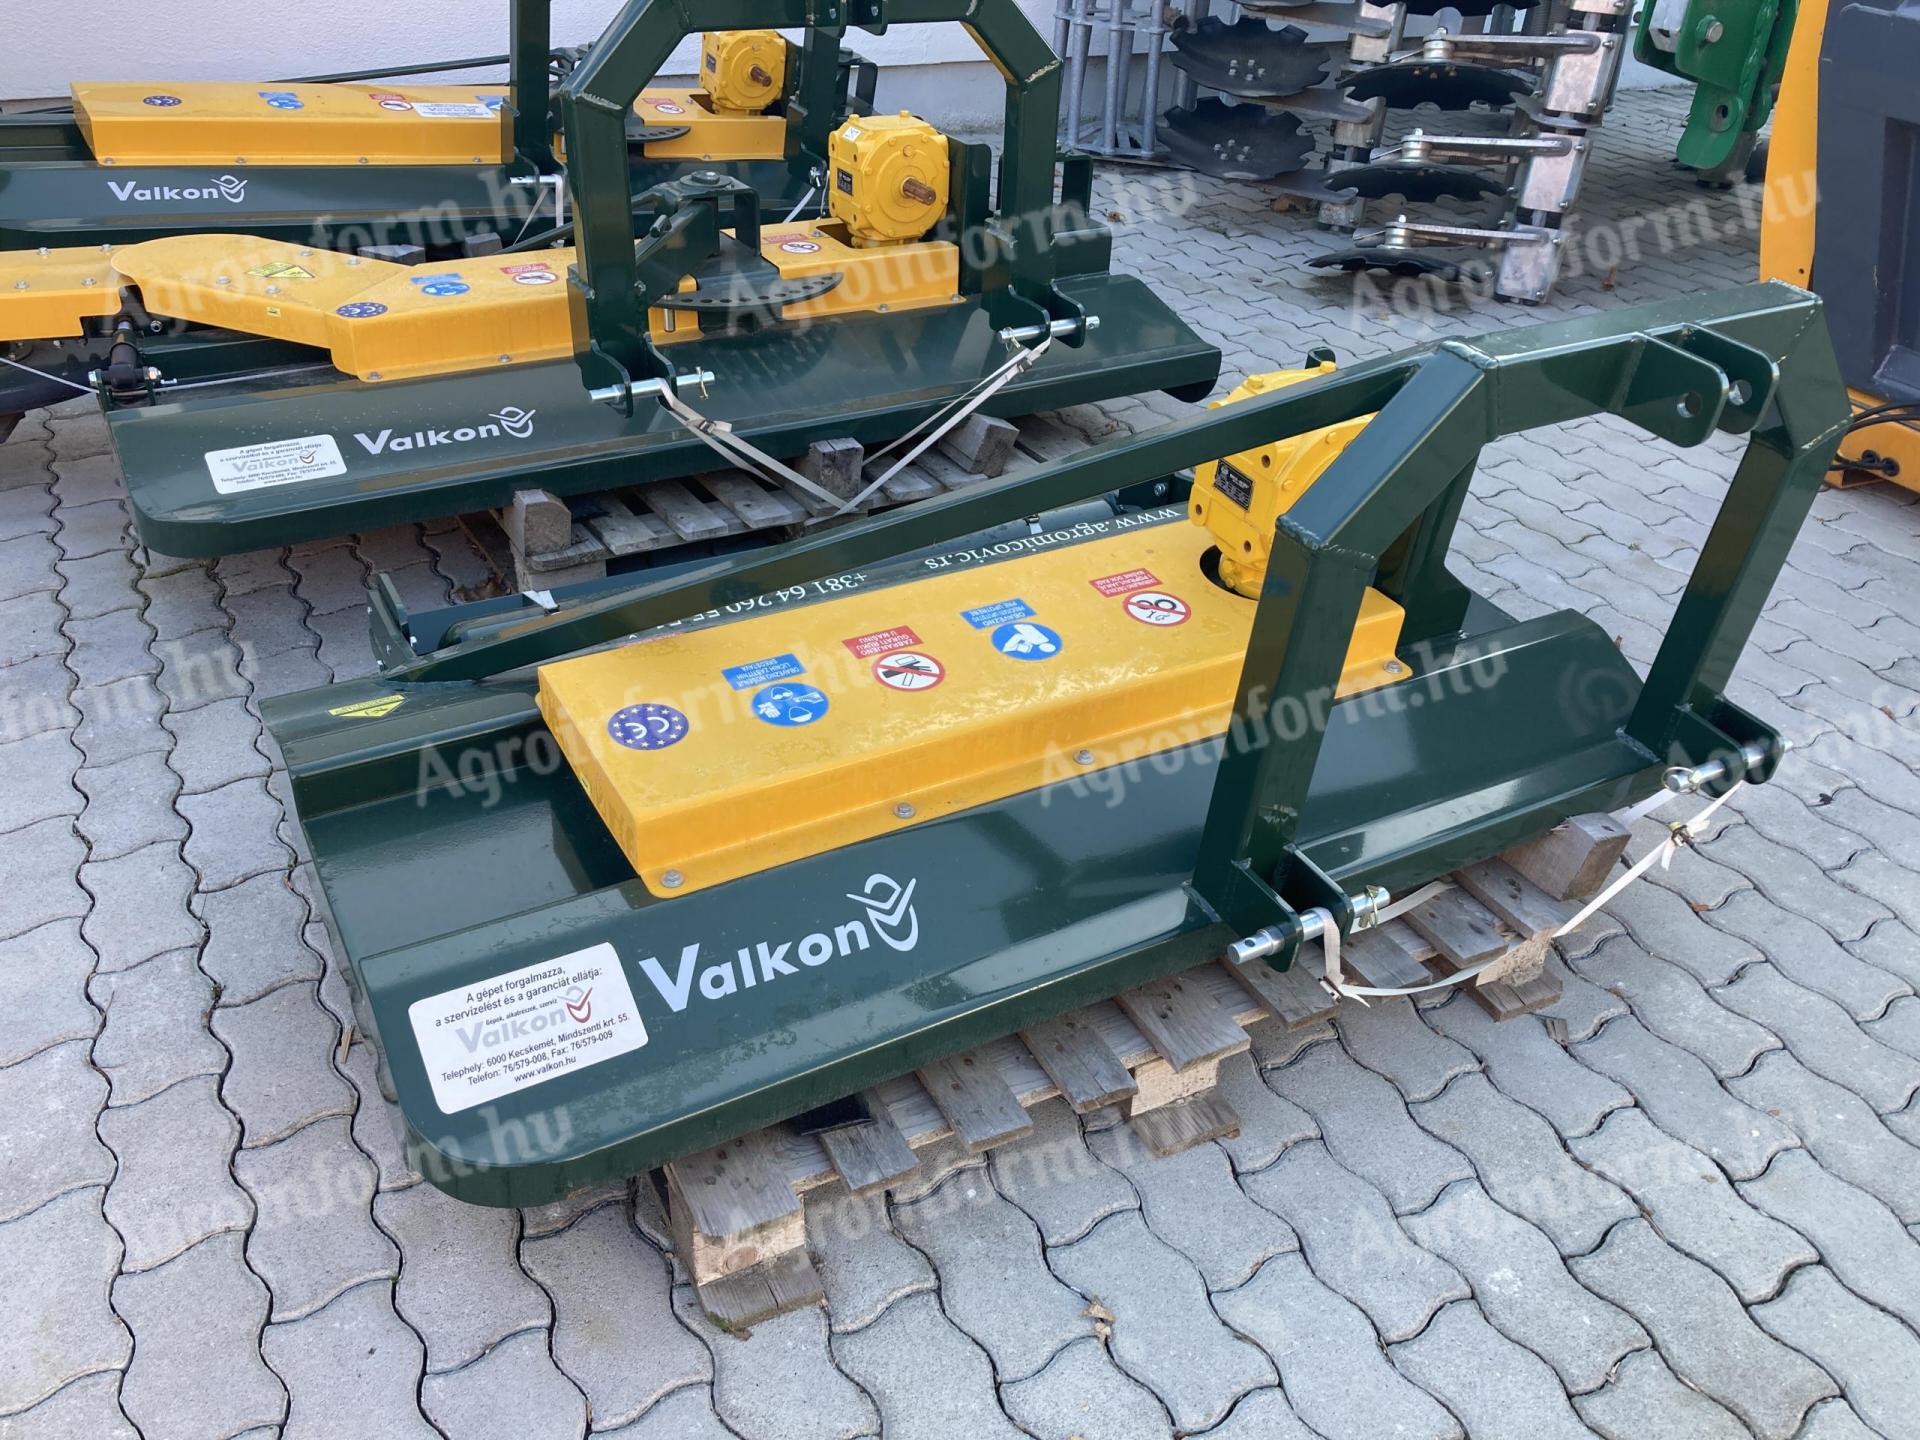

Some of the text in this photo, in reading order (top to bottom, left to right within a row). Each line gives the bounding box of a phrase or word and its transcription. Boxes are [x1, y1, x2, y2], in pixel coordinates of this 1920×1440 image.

[107, 181, 219, 201] Valkon
[353, 424, 500, 455] Valkon
[231, 458, 299, 473] Valkon
[925, 508, 1181, 569] www.agromicovic.rs
[775, 585, 806, 602] 64
[811, 572, 868, 595] +381
[856, 641, 880, 651] RUKU
[860, 638, 914, 656] ZABRANJENO
[624, 716, 670, 739] CE
[638, 920, 870, 1013] Valkon
[435, 967, 603, 1027] a szervizelést és a garanciát ellátja:
[466, 966, 567, 1003] A gépet forgalmazza,
[455, 1008, 567, 1054] Valkon
[441, 1012, 630, 1082] Telephely: 6000 Kecskemét, Mindszenti krt. 55.
[467, 1031, 613, 1086] Telefon: 76/579-008, Fax: 76/579-009
[514, 1055, 577, 1083] www.valkon.hu
